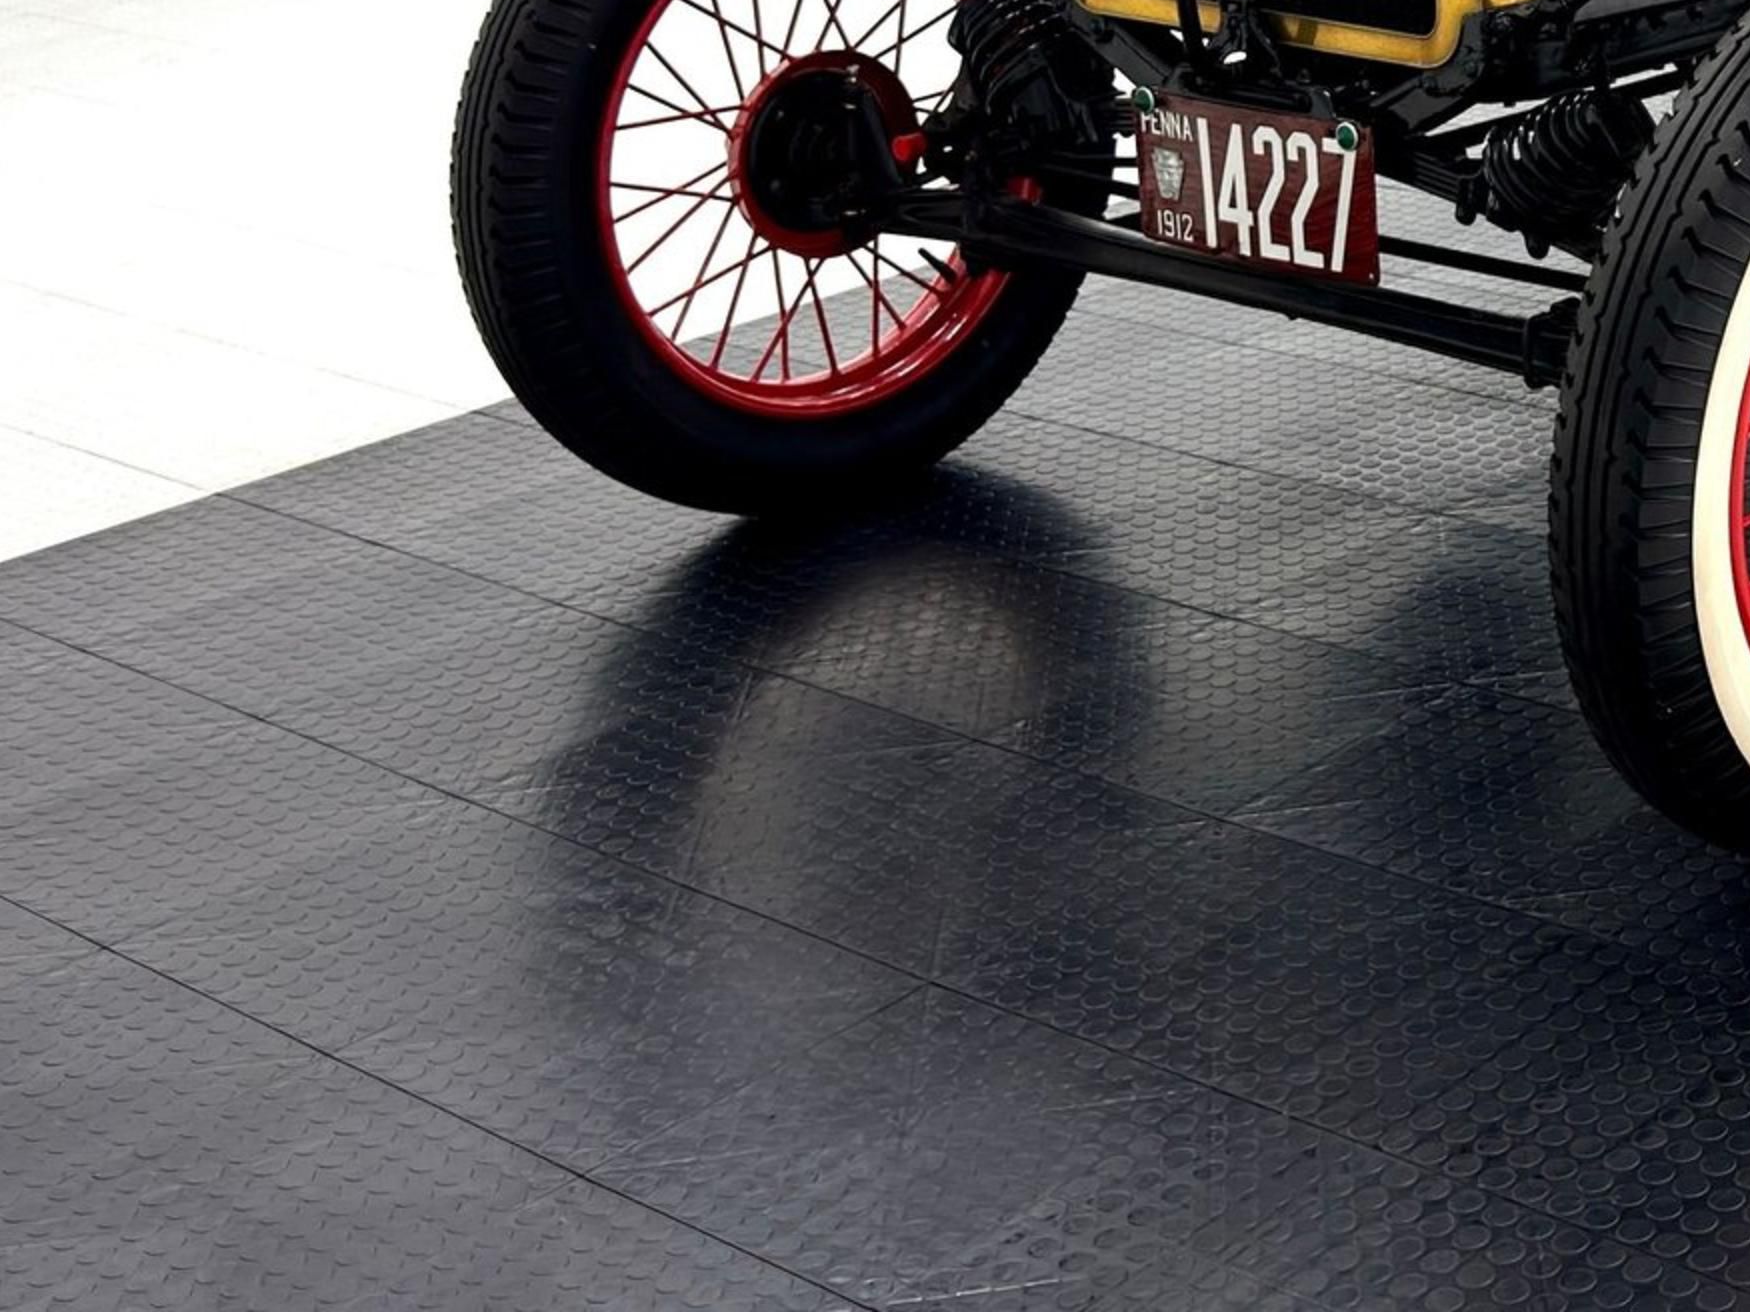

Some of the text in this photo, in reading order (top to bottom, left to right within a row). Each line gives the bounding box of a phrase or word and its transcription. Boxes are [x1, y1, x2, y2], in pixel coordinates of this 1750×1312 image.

[1140, 109, 1193, 142] PENNA
[1197, 117, 1357, 272] 14227
[1156, 209, 1194, 241] 1912
